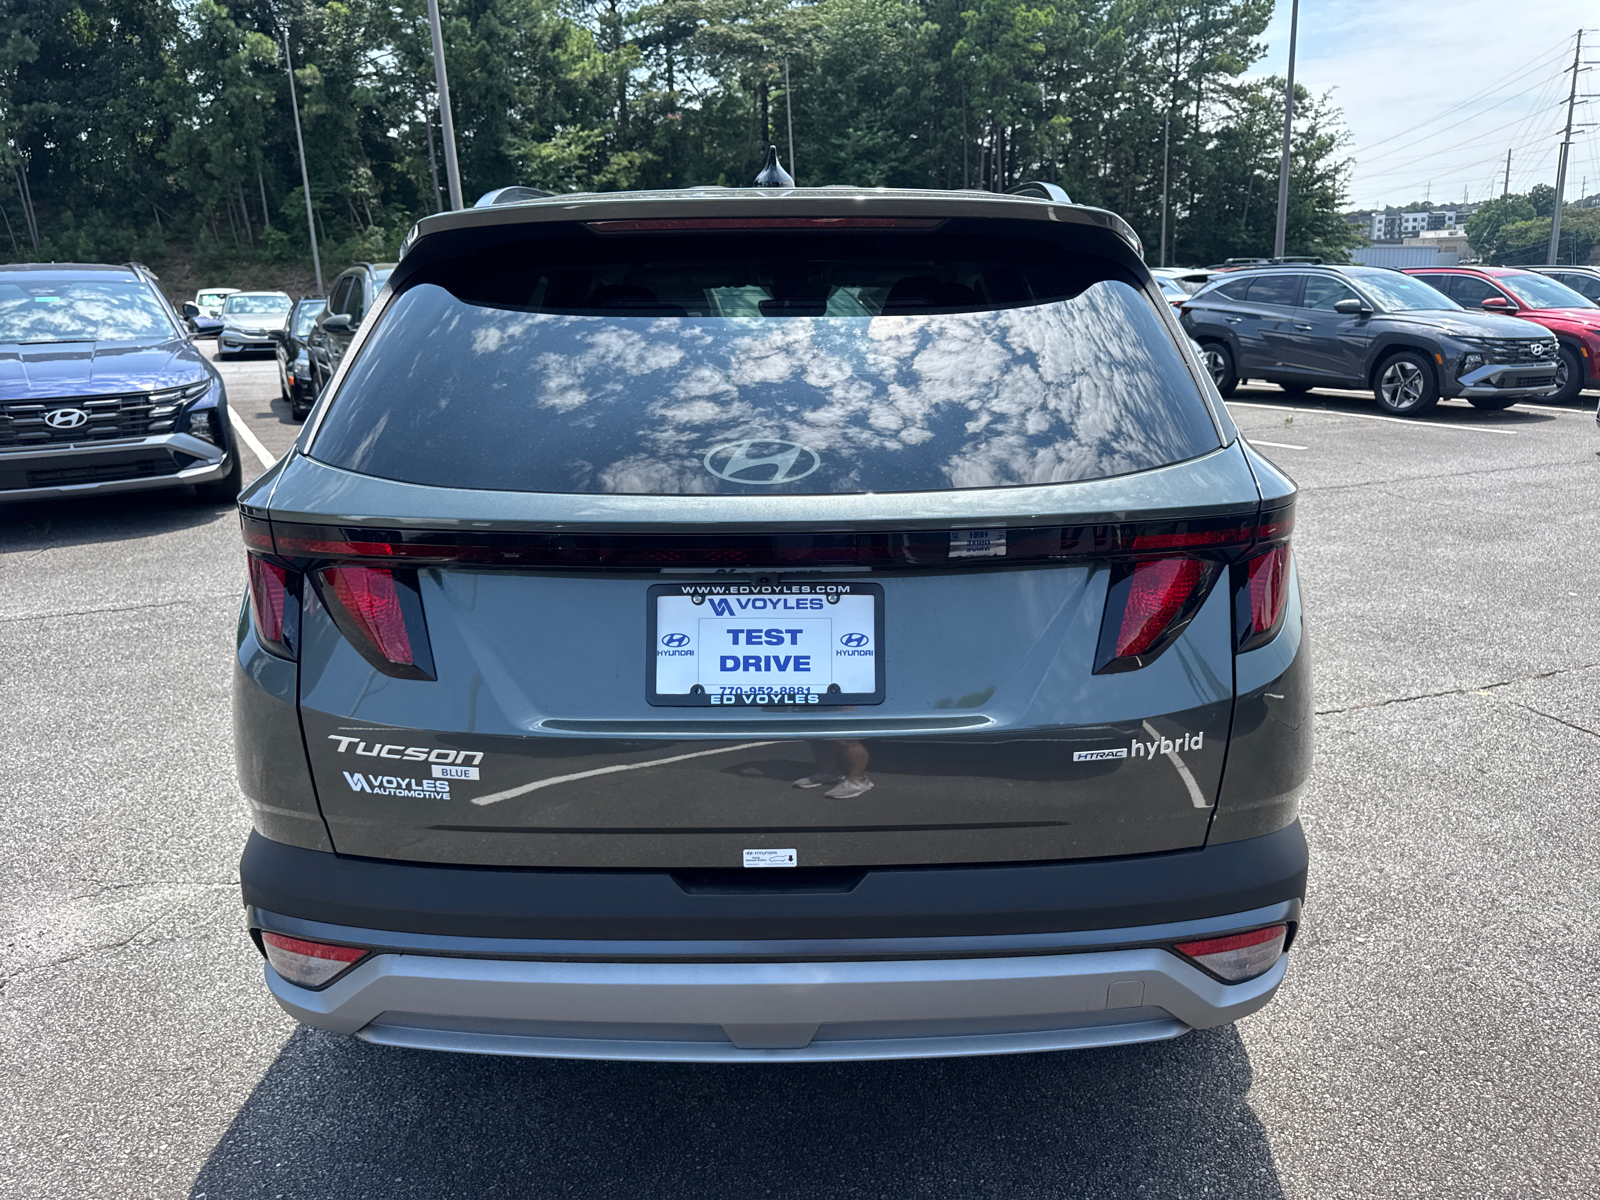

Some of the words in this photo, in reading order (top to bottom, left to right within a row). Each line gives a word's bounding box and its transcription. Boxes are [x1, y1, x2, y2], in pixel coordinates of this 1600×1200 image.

[681, 585, 851, 594] WWW.EDVOYLES.COM
[736, 598, 824, 610] VOYLES
[726, 628, 804, 646] TEST
[719, 655, 811, 672] DRIVE
[719, 686, 811, 695] 770-952-8881
[710, 695, 739, 704] ED
[742, 694, 820, 704] VOYLES
[327, 734, 485, 766] Tucson
[1131, 731, 1204, 760] hybrid
[1077, 750, 1124, 760] HTRAC
[441, 768, 471, 778] BLUE
[368, 774, 450, 792] VOYLES
[372, 787, 451, 800] AUTOMOTIVE
